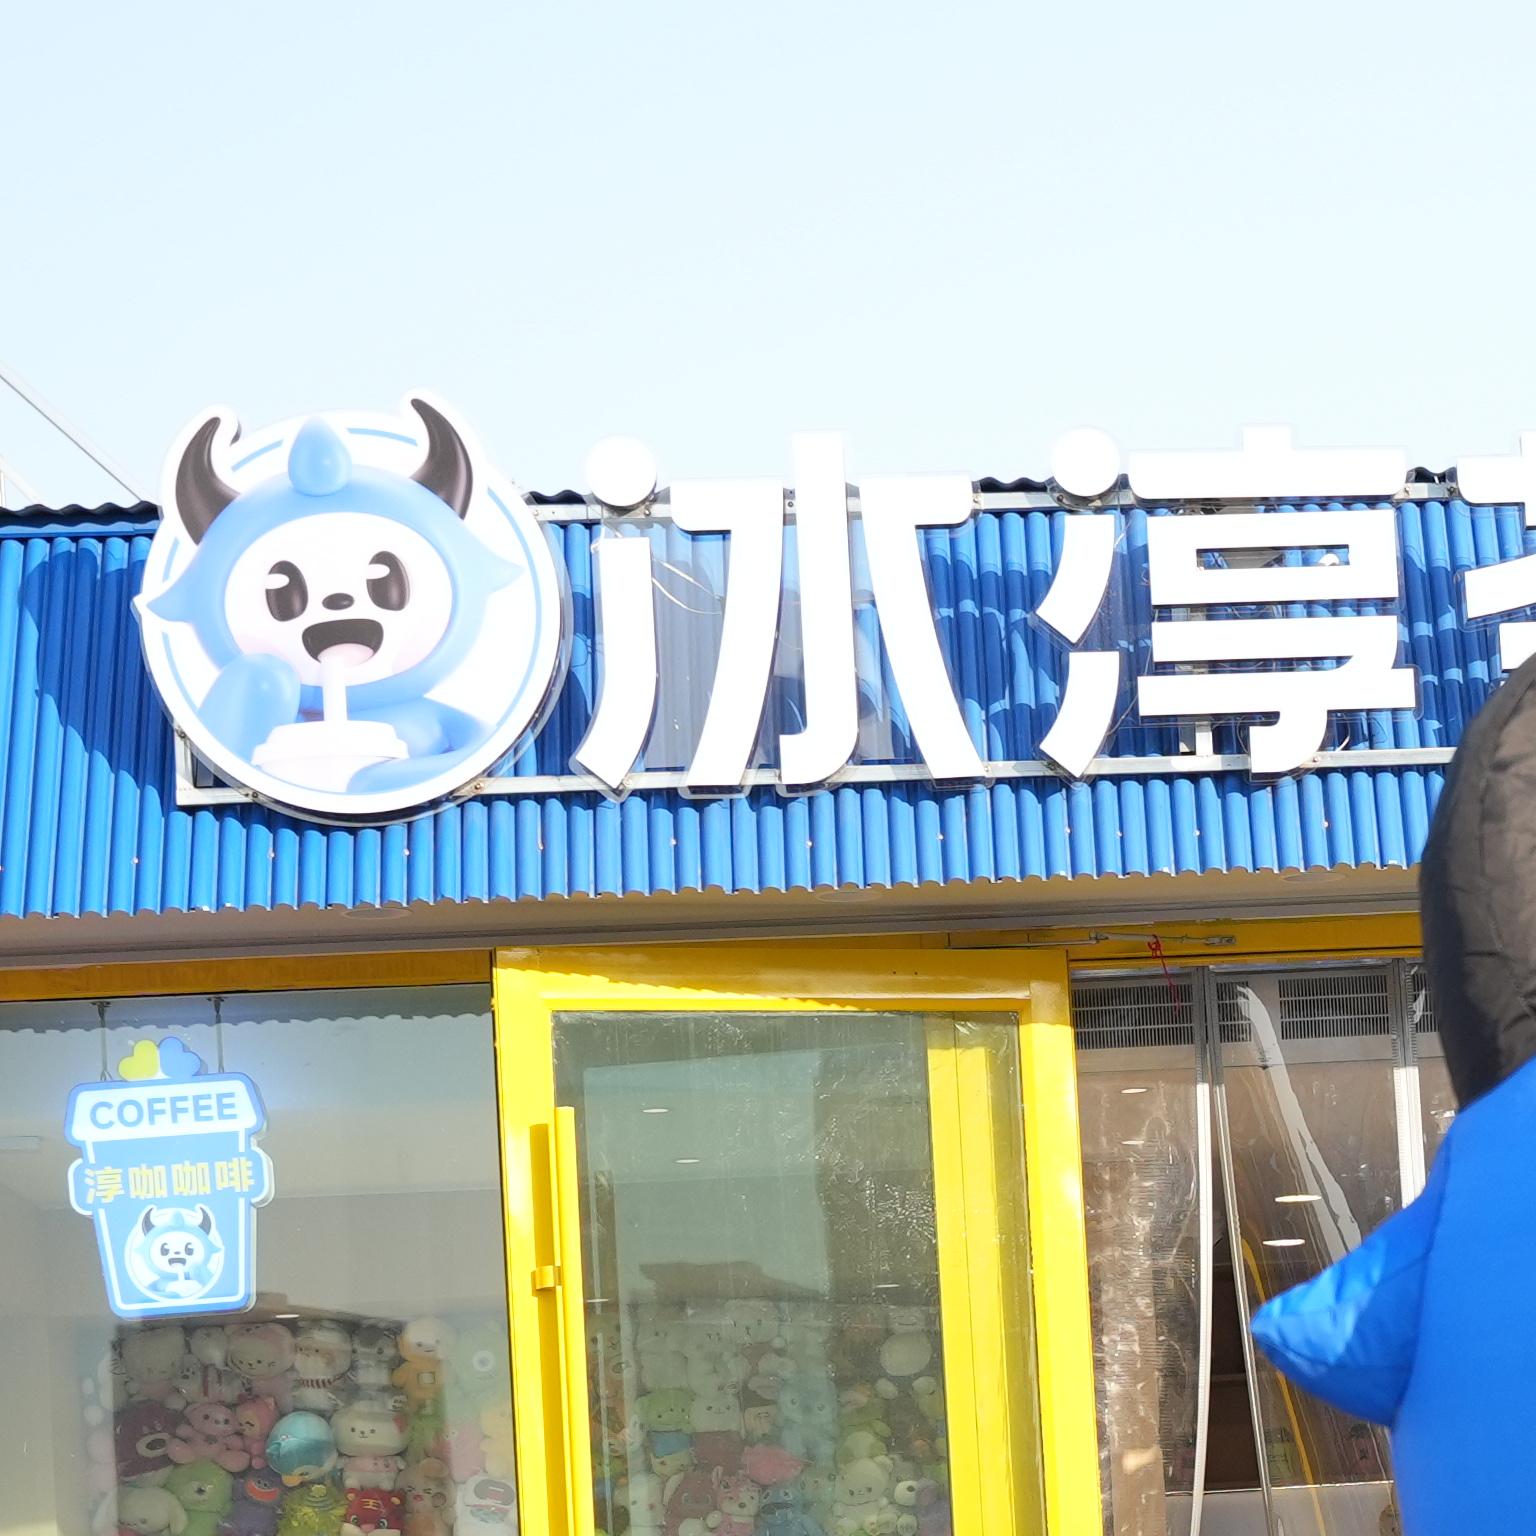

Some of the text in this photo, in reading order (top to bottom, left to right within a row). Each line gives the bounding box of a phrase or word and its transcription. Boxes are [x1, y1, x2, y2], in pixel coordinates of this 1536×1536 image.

[89, 1092, 239, 1130] COFFEE
[83, 1157, 255, 1204] 淳咖咖啡
